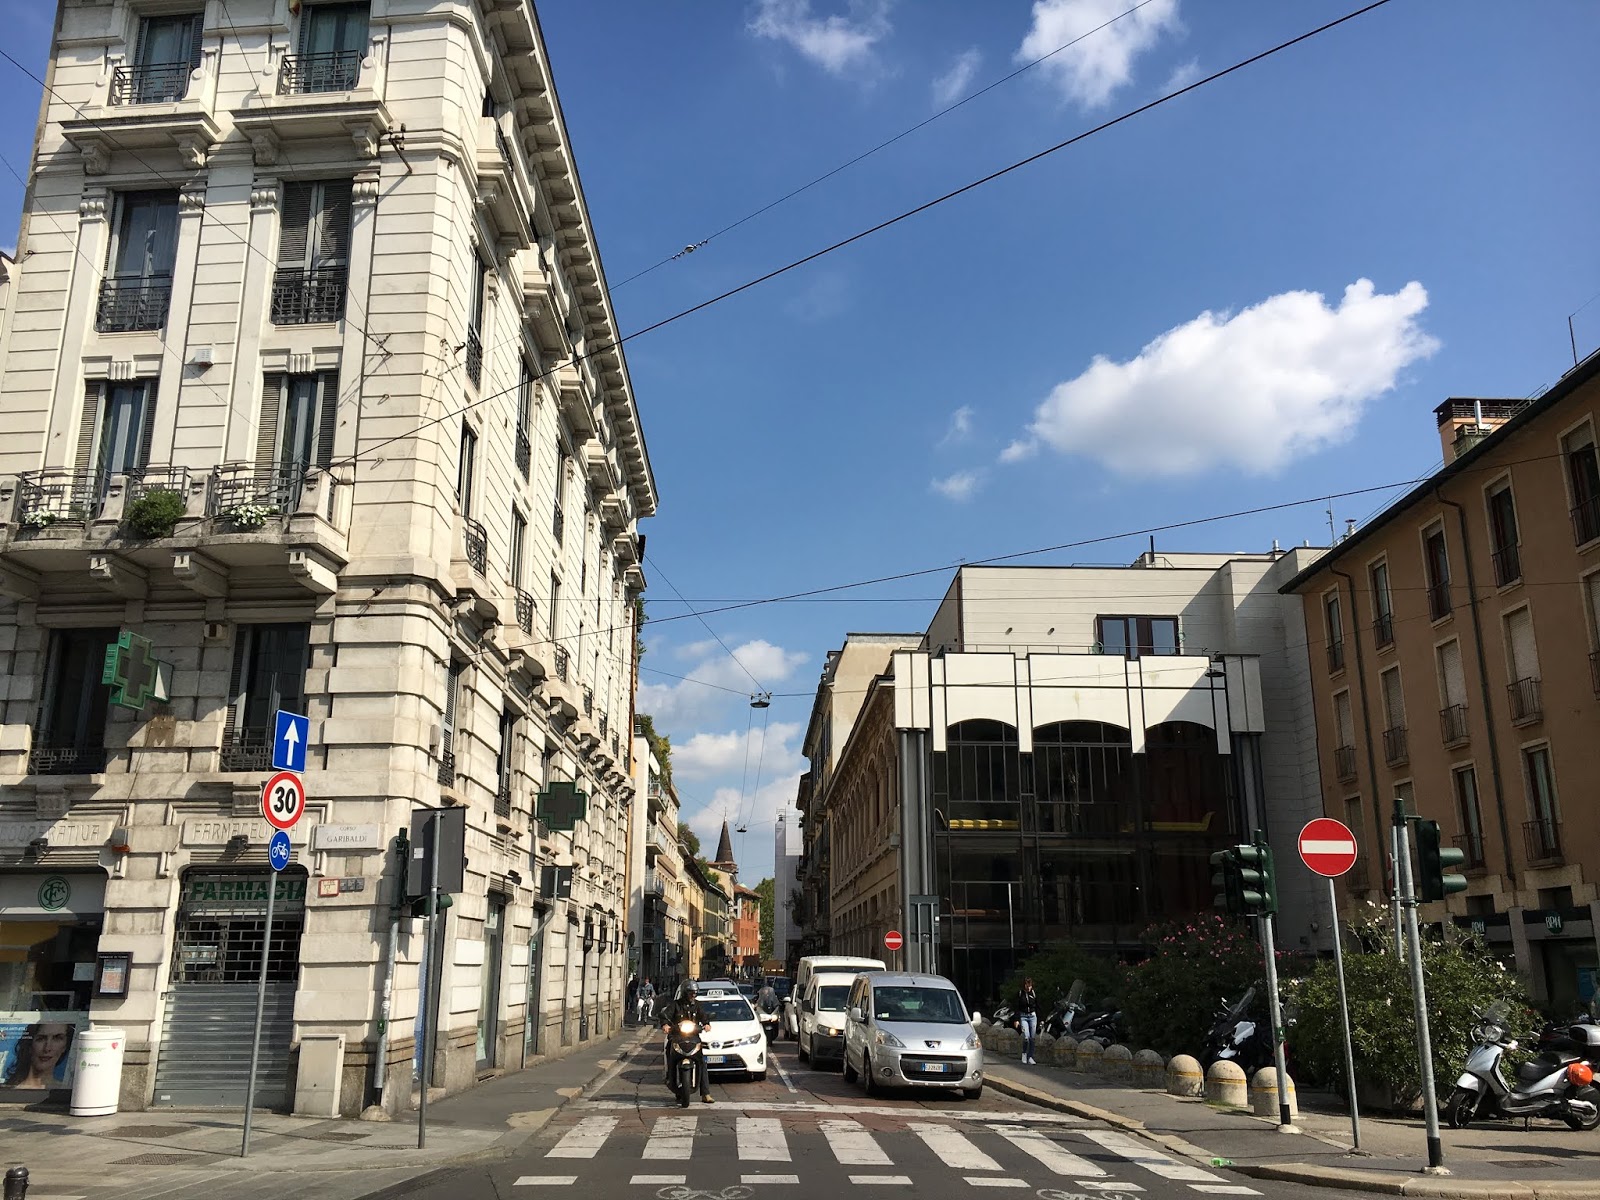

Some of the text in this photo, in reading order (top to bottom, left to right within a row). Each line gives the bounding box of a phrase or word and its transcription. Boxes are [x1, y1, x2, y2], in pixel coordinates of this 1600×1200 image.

[273, 786, 297, 814] 30
[193, 822, 298, 840] FARMACEUA
[326, 835, 368, 843] GARIBALDI
[190, 881, 305, 900] FARMACIA
